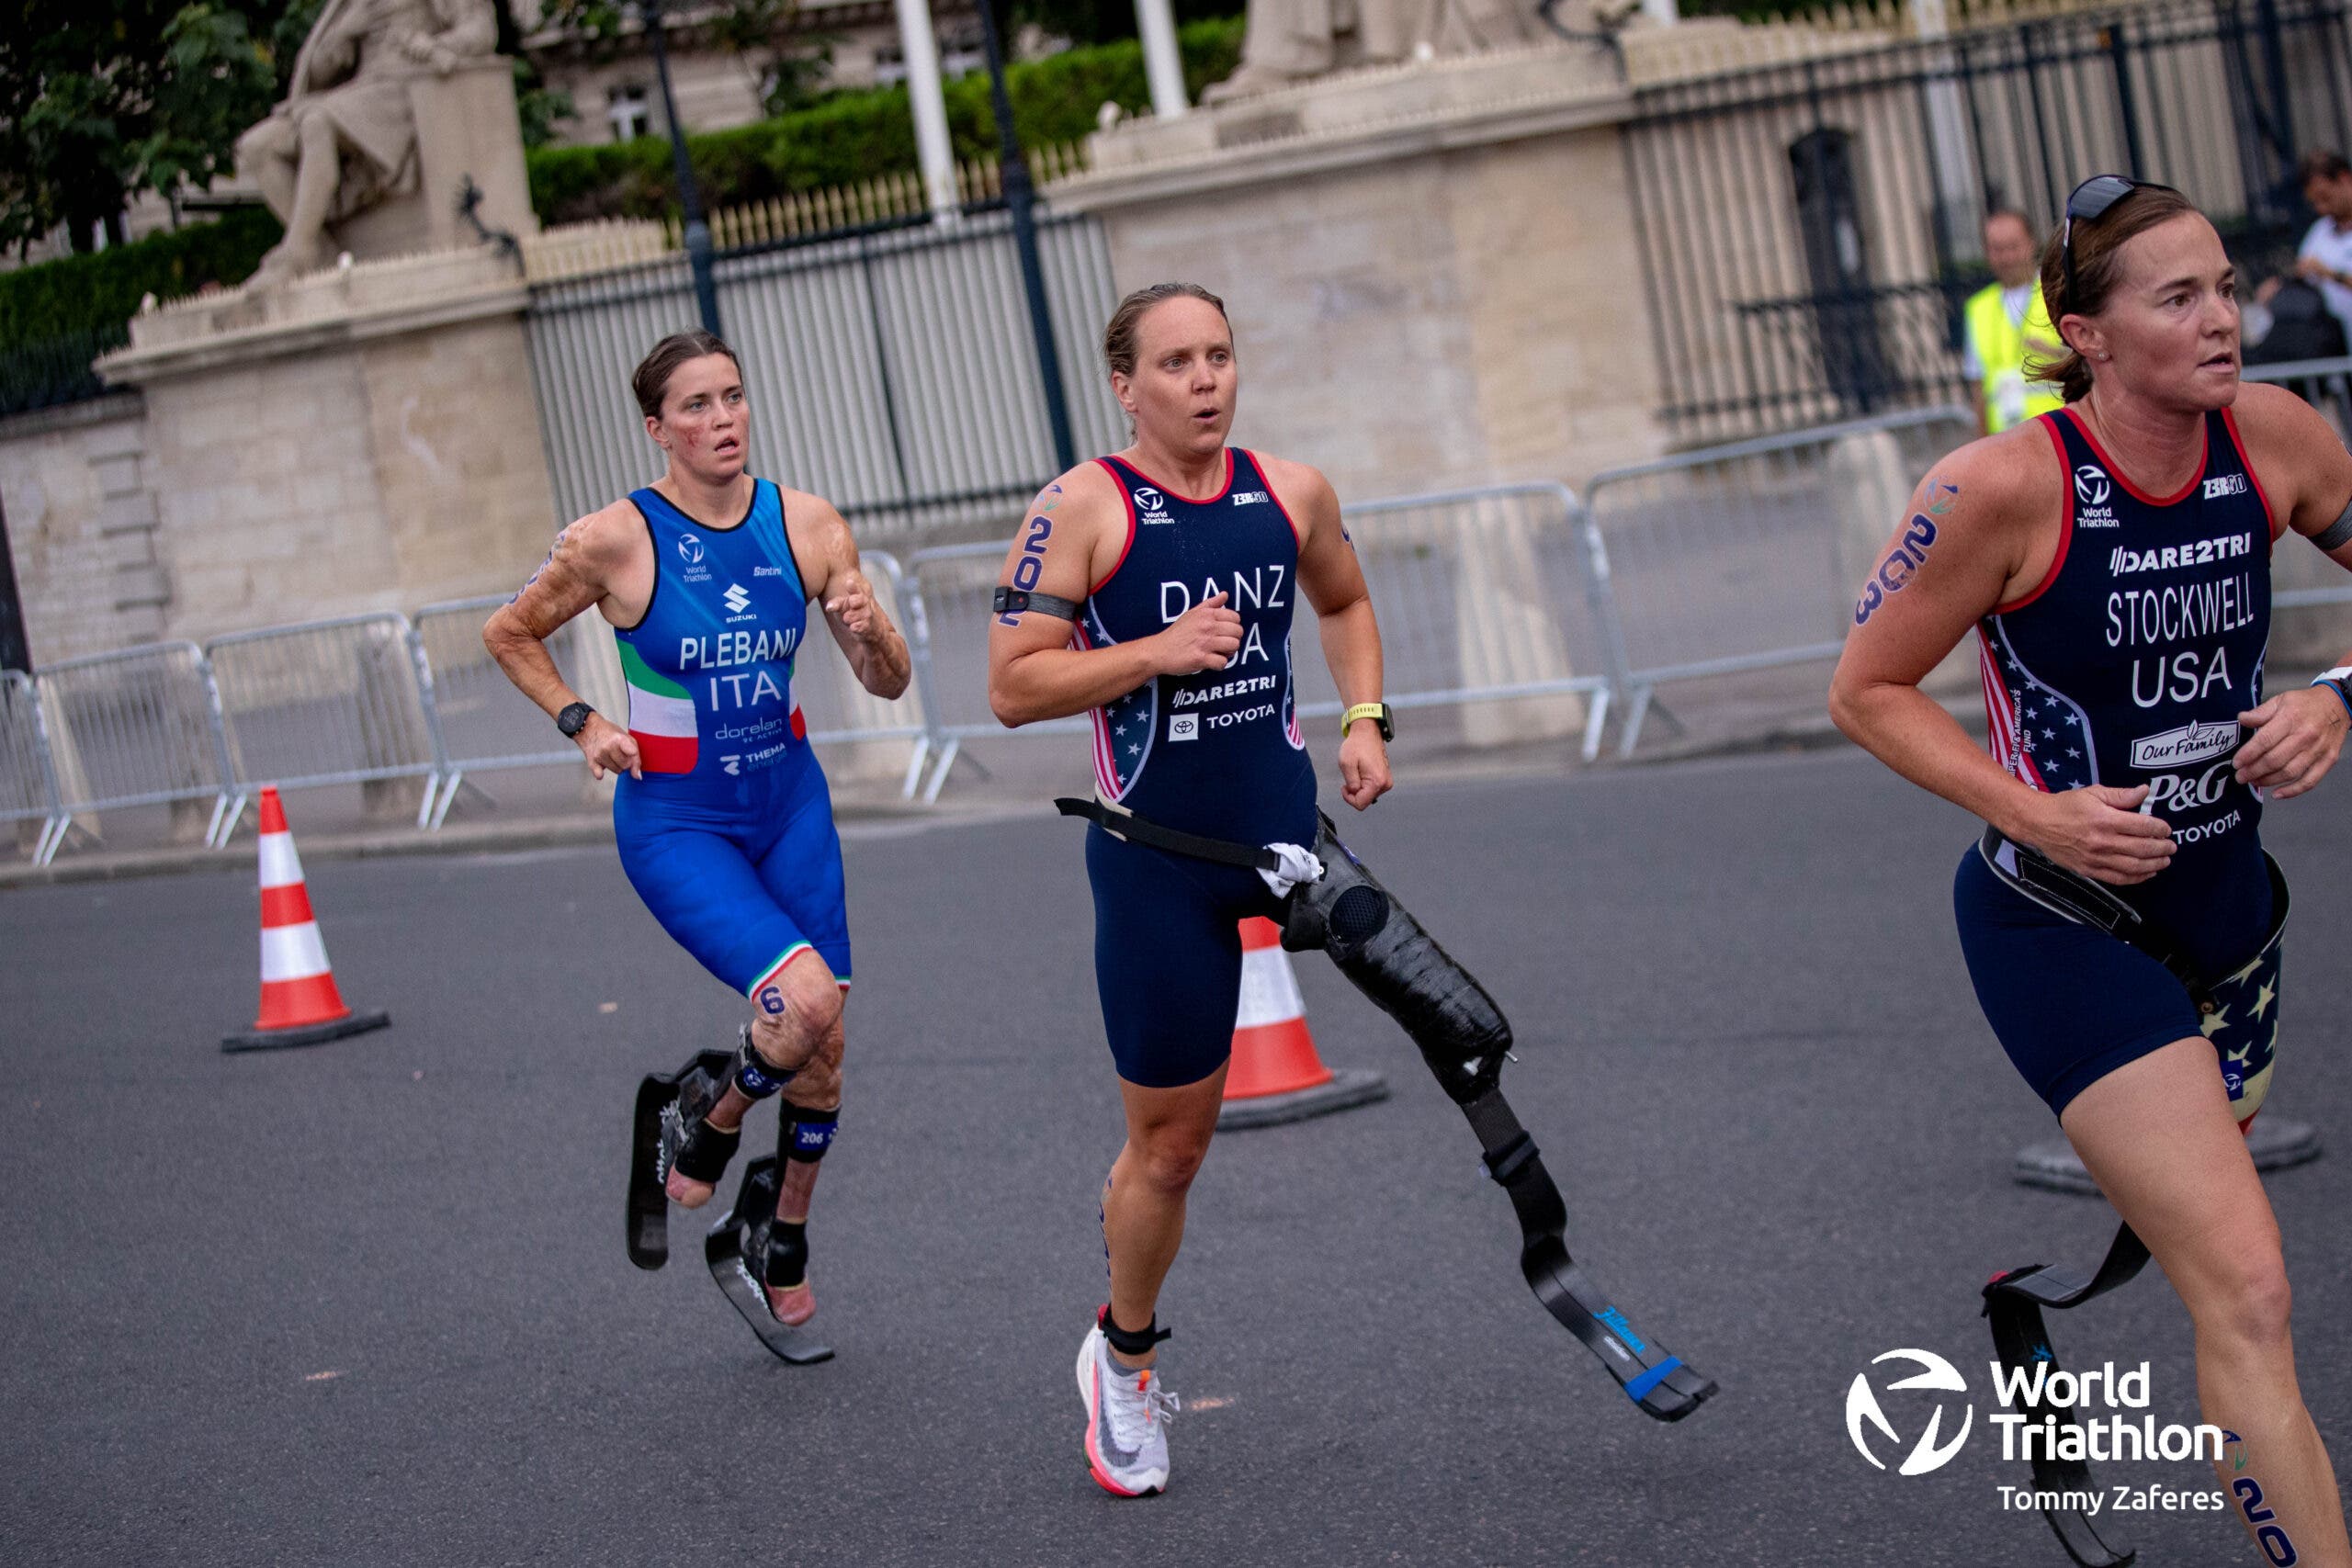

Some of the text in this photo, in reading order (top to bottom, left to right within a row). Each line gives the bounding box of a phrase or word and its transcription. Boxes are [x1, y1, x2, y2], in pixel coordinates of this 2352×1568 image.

[2077, 517, 2120, 528] Triathlon
[2083, 507, 2112, 518] World
[683, 574, 712, 582] Triathlon
[685, 565, 707, 574] World
[753, 566, 782, 577] Santini
[1855, 513, 1938, 626] 203
[1160, 565, 1285, 624] DANZ
[726, 614, 757, 624] SUZUKI
[2106, 572, 2254, 647] STOCKWELL
[679, 627, 797, 671] PLEBANI
[2132, 646, 2233, 708] USA
[710, 671, 782, 712] ITA
[715, 716, 783, 739] dorelan
[1206, 704, 1276, 728] TOYOTA
[745, 742, 786, 762] THEMA
[2023, 729, 2031, 752] FUND
[2143, 730, 2235, 761] Our Family
[2139, 760, 2233, 816] P&G
[2173, 809, 2241, 844] TOYOTA
[800, 1131, 824, 1145] 206
